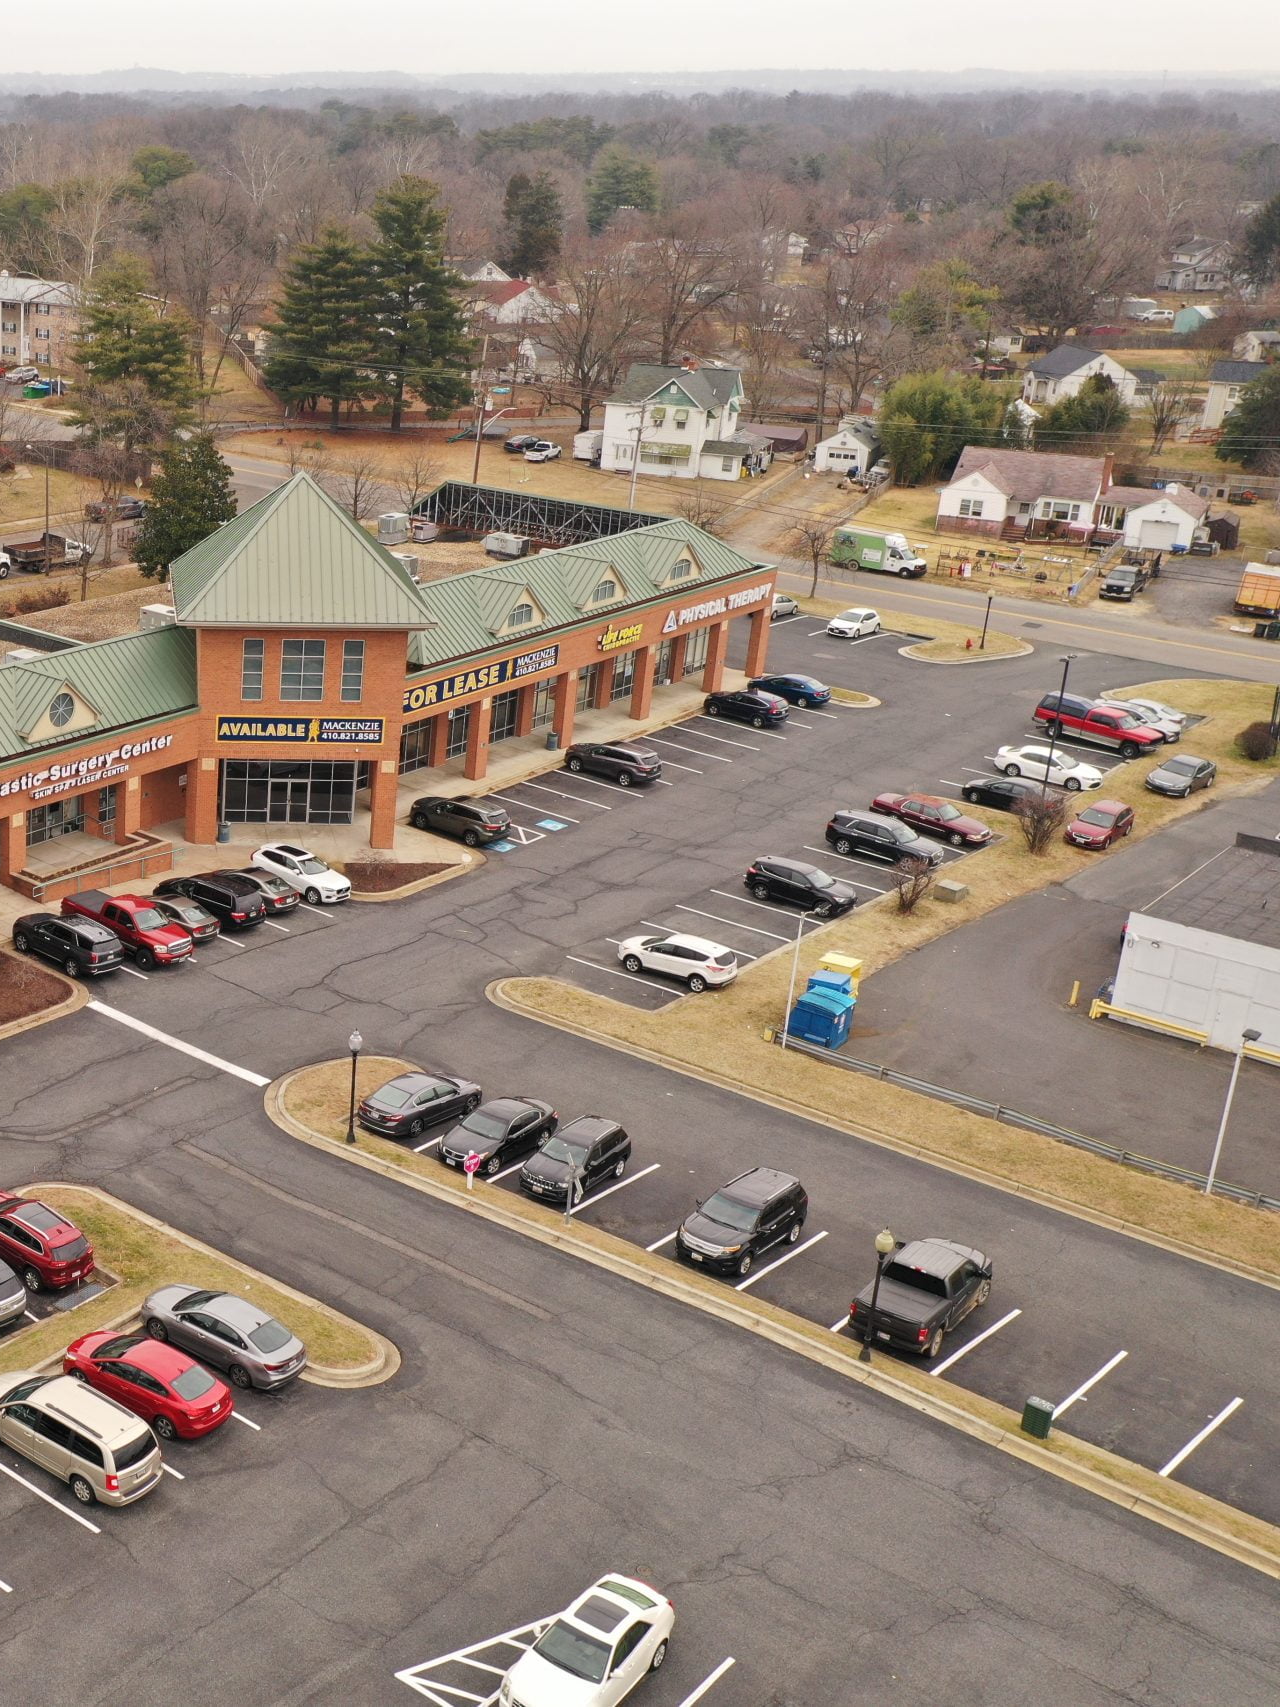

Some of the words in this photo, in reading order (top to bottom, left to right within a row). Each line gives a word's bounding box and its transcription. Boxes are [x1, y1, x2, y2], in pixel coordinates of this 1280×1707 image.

[679, 598, 727, 625] PHYSICAL
[728, 583, 773, 610] THERAPY
[618, 623, 643, 640] FORCE
[517, 647, 556, 667] MACKENZIE
[515, 658, 555, 677] 410.821.8585
[442, 665, 500, 700] LEASE
[219, 722, 306, 737] AVAILABLE
[322, 721, 380, 731] MACKENZIE
[321, 732, 380, 740] 410.821.8585
[49, 752, 113, 781] Surgery
[120, 734, 174, 760] Center
[34, 785, 52, 800] SKIN
[54, 782, 70, 793] SPA
[77, 772, 100, 786] LASER
[102, 765, 129, 778] CENTER
[466, 1157, 479, 1166] STOP
